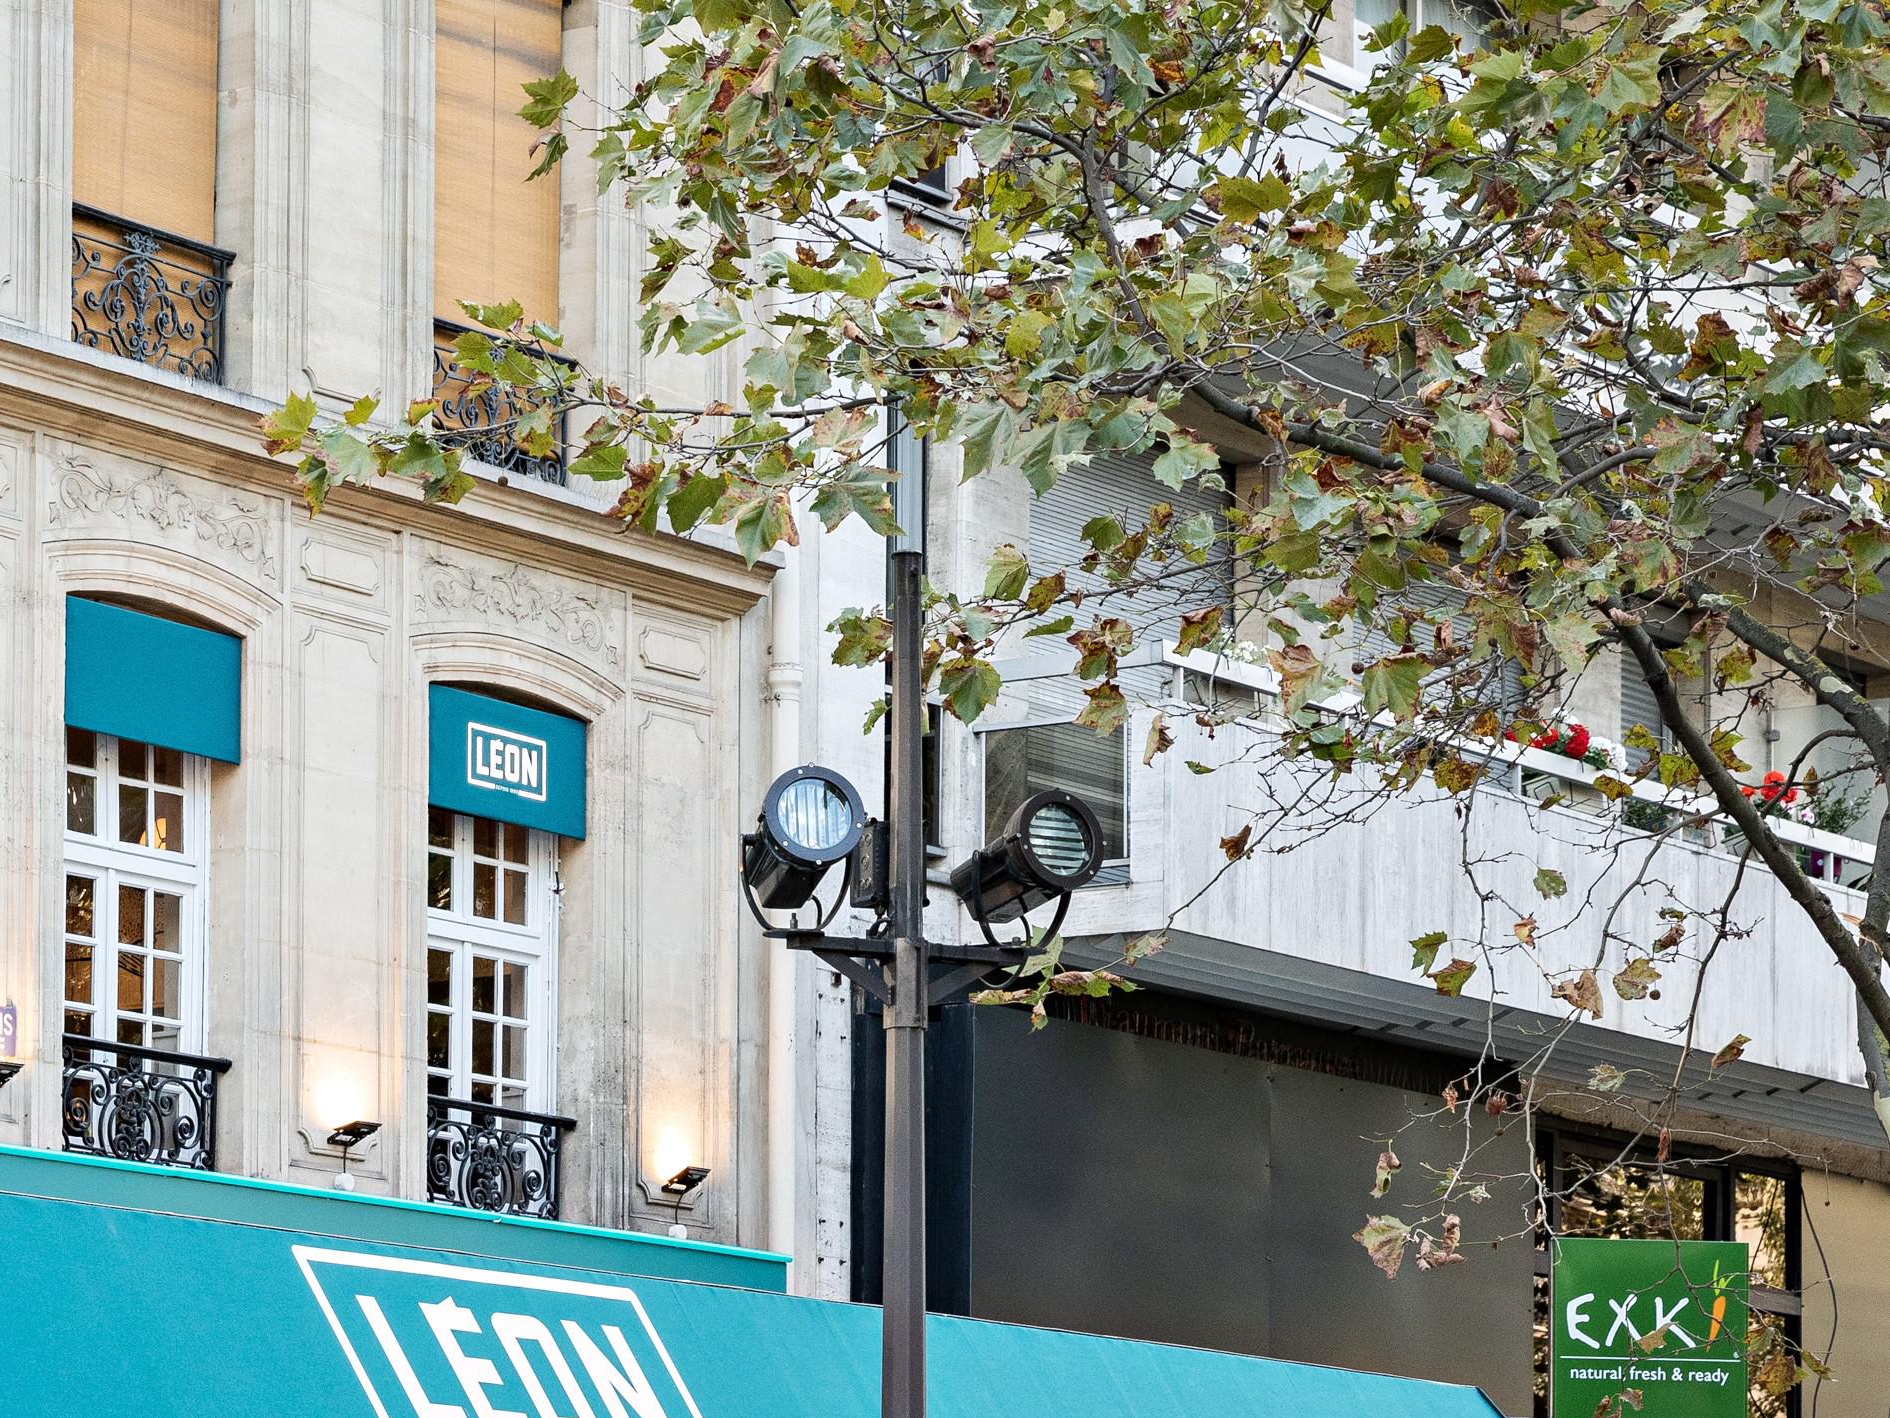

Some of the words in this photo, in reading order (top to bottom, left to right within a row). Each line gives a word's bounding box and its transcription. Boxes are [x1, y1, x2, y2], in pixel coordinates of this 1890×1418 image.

[476, 736, 538, 788] LÉON
[1629, 1365, 1667, 1382] fresh
[1672, 1368, 1683, 1382] &
[1688, 1368, 1730, 1386] ready
